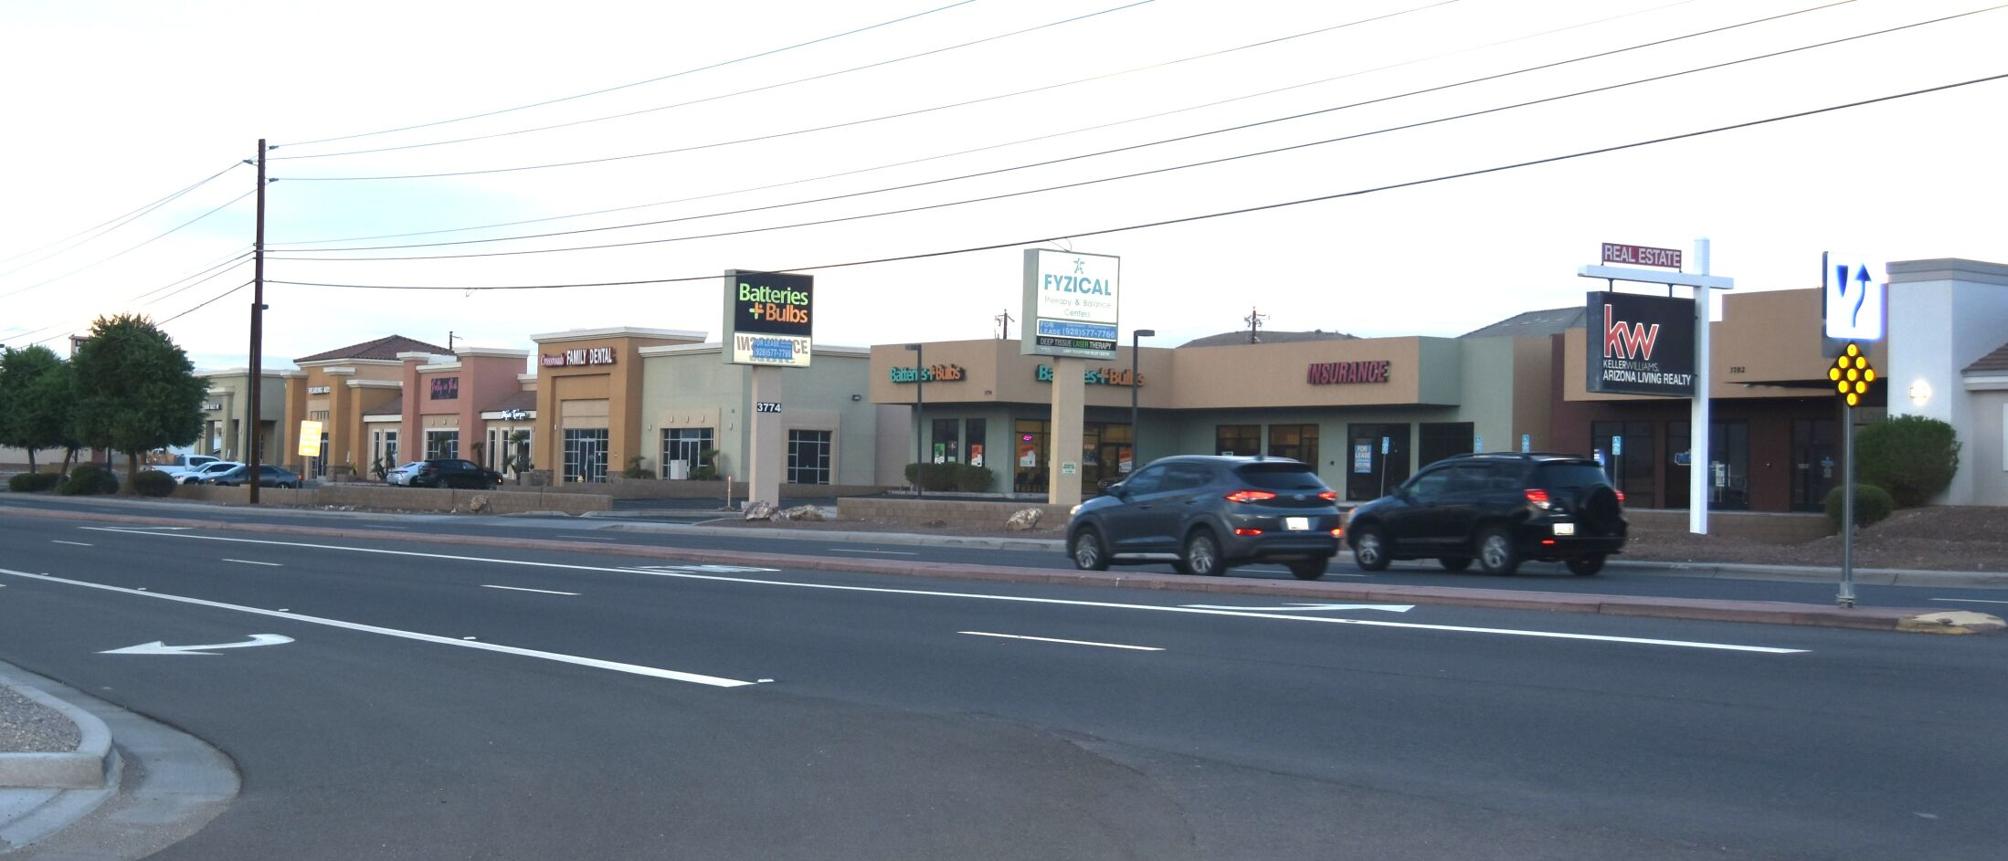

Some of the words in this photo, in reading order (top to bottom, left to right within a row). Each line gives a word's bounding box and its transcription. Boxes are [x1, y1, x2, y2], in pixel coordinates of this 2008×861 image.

[1604, 244, 1636, 263] REAL
[1638, 248, 1681, 267] ESTATE
[739, 283, 808, 306] Batteries
[1044, 274, 1111, 295] FYZICAL
[1089, 341, 1112, 351] THERAPY
[566, 349, 587, 366] FAMILY
[589, 347, 613, 364] DENTAL
[1307, 361, 1388, 384] INSURANCE
[1602, 369, 1636, 382] ARIZONA
[1637, 371, 1662, 384] LIVING
[1663, 373, 1692, 386] REALTY
[757, 402, 781, 413] 3774
